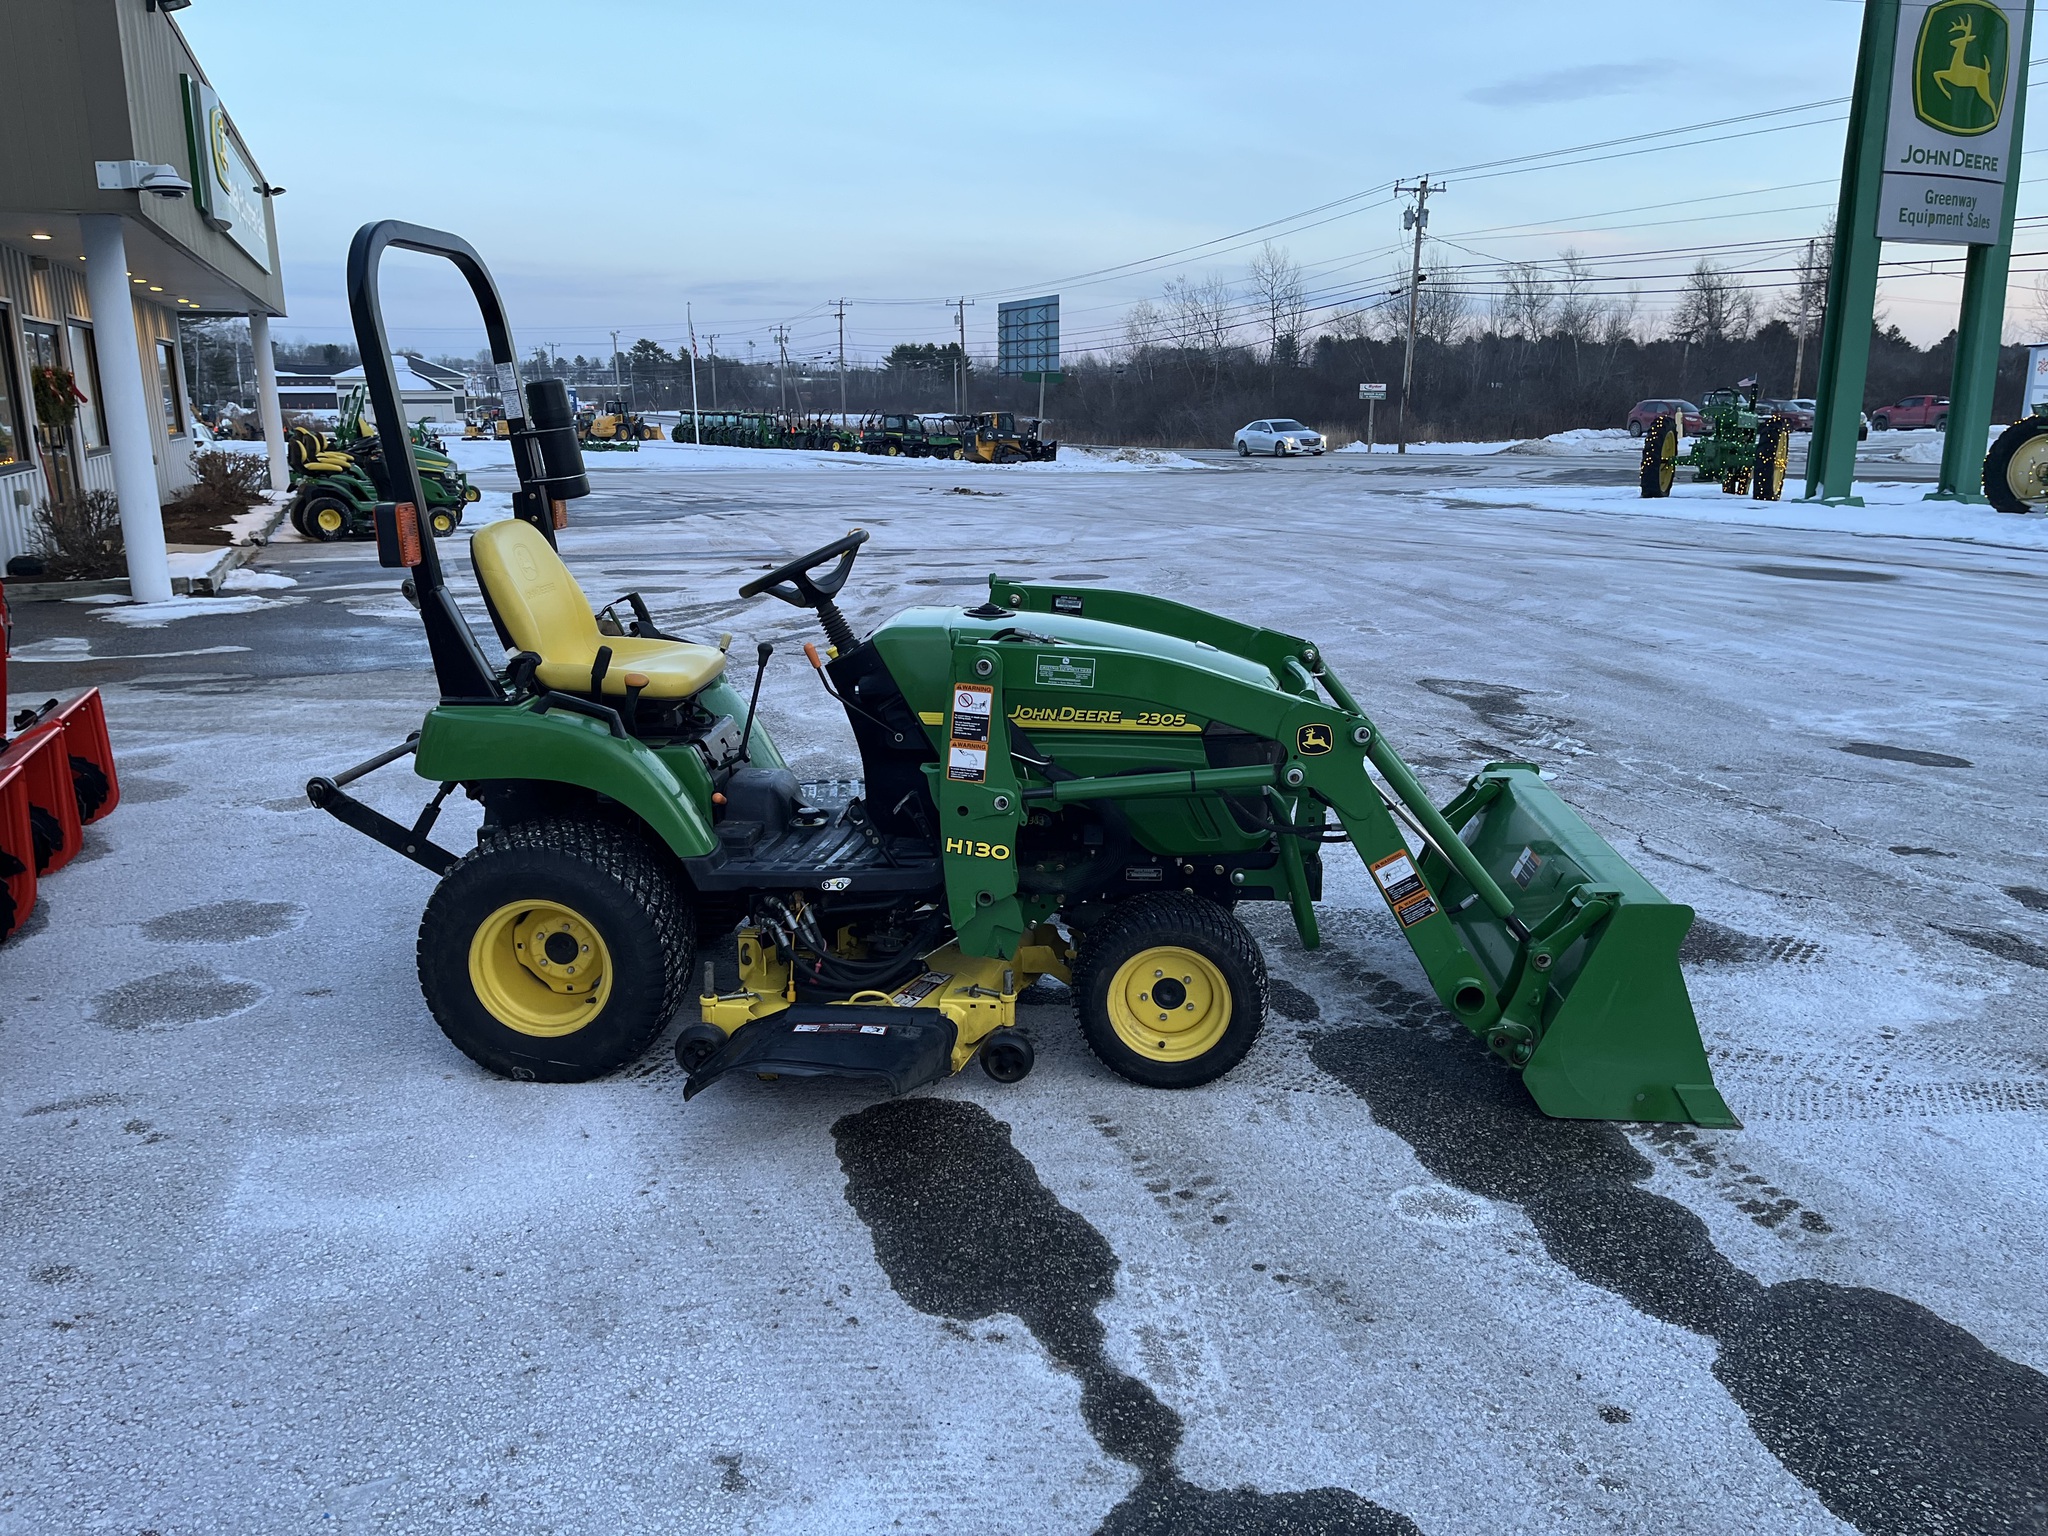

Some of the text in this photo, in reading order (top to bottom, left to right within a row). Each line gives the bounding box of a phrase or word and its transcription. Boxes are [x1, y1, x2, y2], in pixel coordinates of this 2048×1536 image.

[1901, 144, 1999, 172] JOHN DEERE
[1925, 189, 1977, 211] Greenway
[1898, 207, 1991, 229] Equipment Sales
[962, 685, 991, 693] WARNING
[1008, 704, 1187, 726] JOHN DEERE 2305
[958, 742, 986, 750] WARNING
[945, 837, 1011, 860] H130
[1380, 852, 1402, 866] WARNING
[1404, 893, 1426, 907] WARNING
